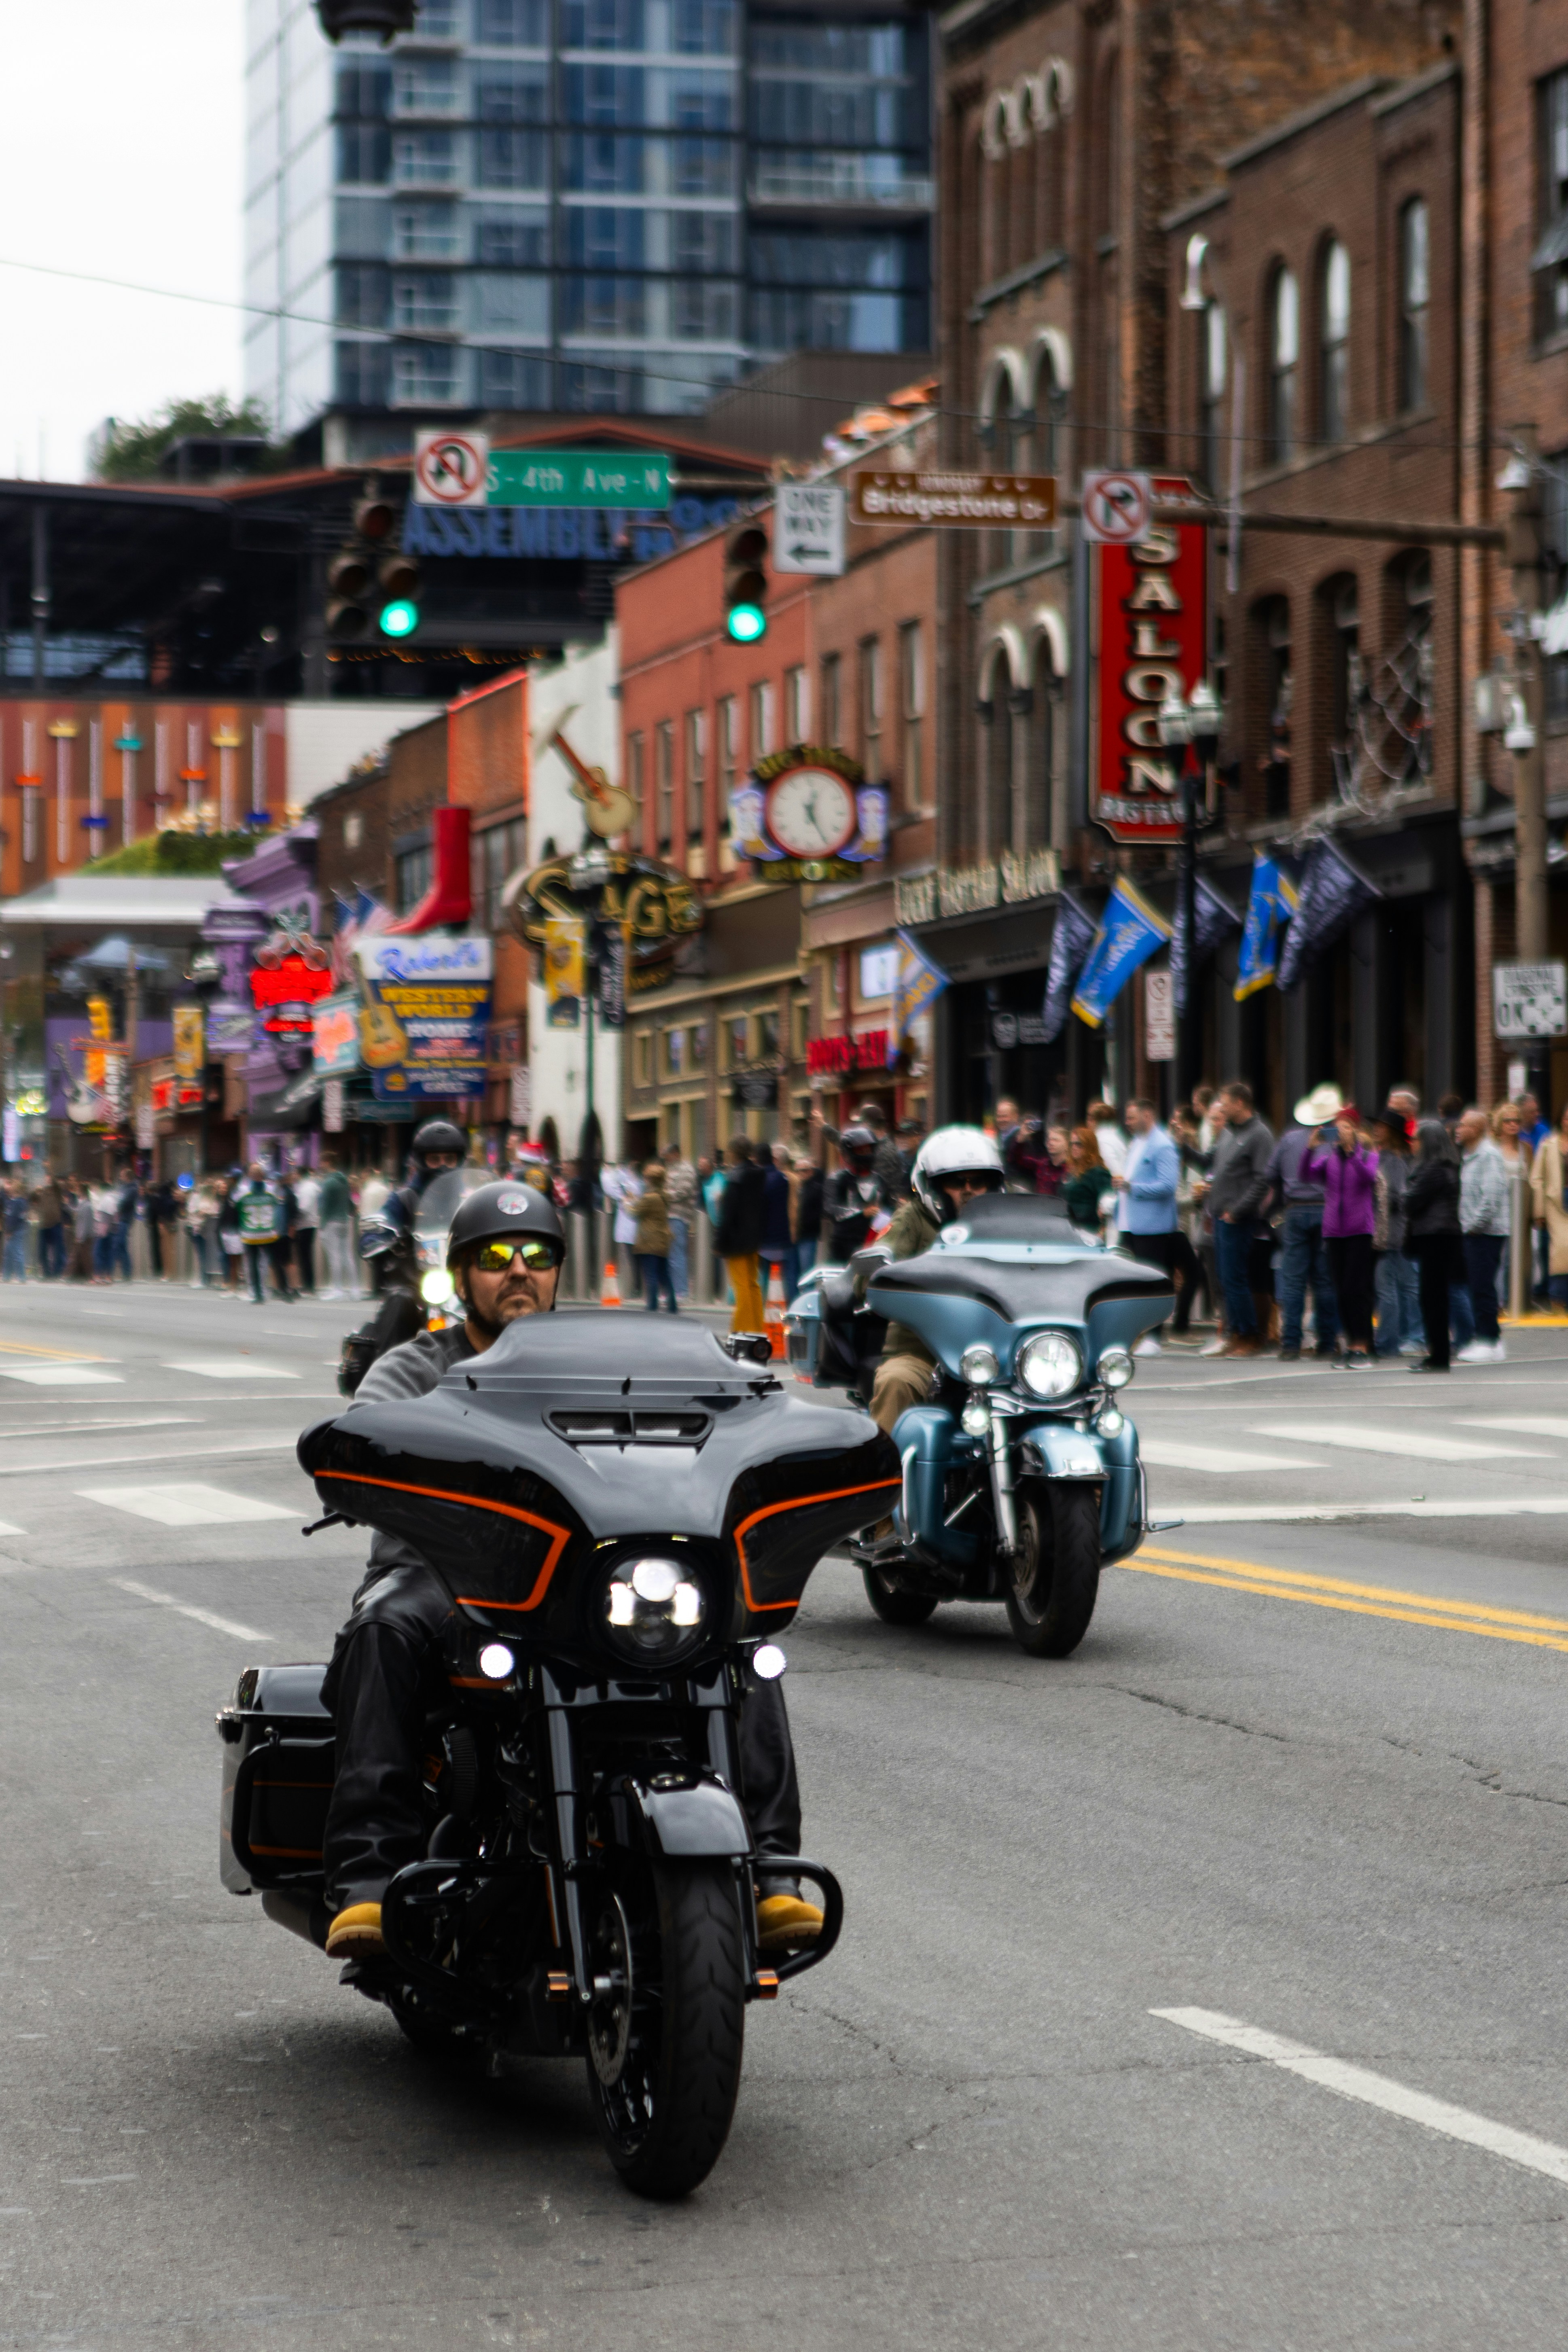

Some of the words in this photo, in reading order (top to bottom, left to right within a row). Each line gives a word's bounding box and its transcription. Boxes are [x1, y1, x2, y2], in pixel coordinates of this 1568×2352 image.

[785, 491, 833, 515] ONE
[862, 485, 1017, 521] Bridgestone
[785, 514, 832, 539] WAY
[1124, 526, 1182, 794] SALOON
[523, 867, 704, 943] SAGE
[376, 942, 482, 985] Robert's
[379, 986, 489, 1003] WESTERN
[393, 1003, 475, 1018] WORLD
